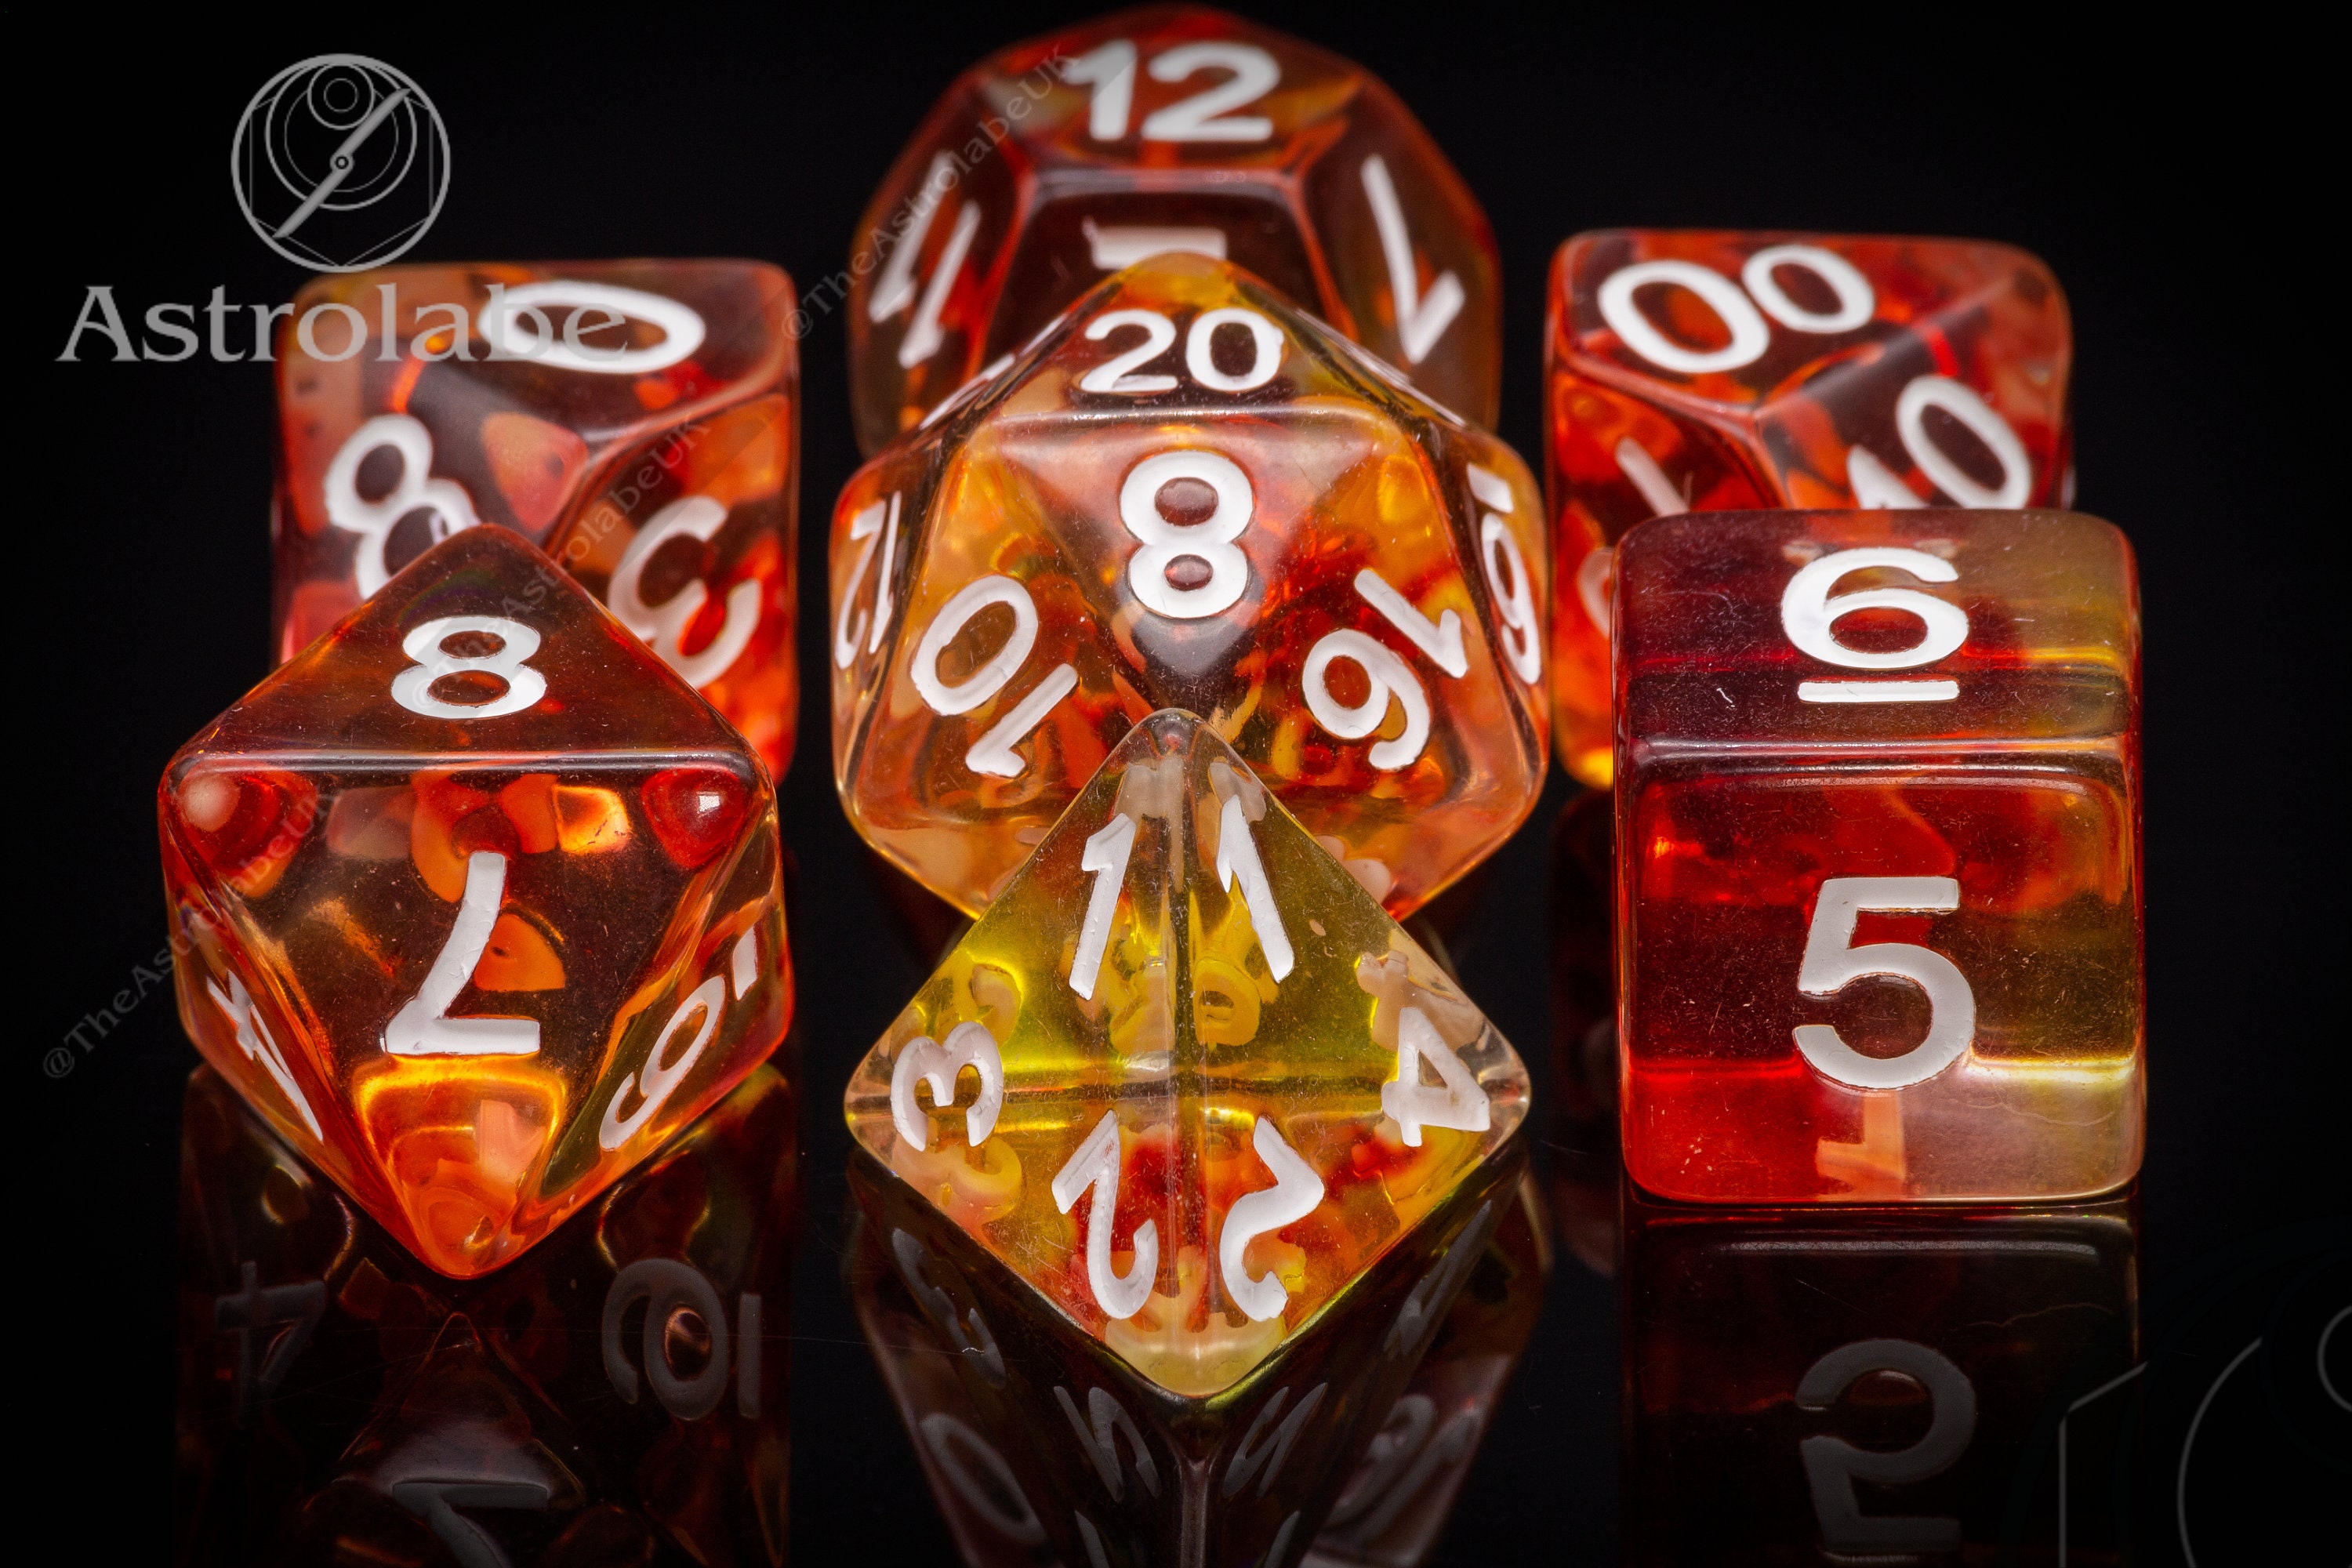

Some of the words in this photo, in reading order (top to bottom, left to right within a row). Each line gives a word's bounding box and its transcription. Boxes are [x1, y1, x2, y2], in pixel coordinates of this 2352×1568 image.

[1062, 38, 1281, 143] 12
[1080, 307, 1283, 394] 20
[1597, 245, 1876, 374] 00
[1120, 449, 1254, 619] 8
[390, 615, 547, 720] 8
[910, 574, 1078, 779] 10
[1301, 568, 1468, 771] 16
[1780, 546, 1970, 704] 6
[382, 851, 542, 1057] 7
[1068, 811, 1138, 1000] 1
[1215, 794, 1295, 984] 1
[1791, 875, 1976, 1091] 5
[890, 1021, 1005, 1152] 3
[1380, 1006, 1491, 1148] 4
[1051, 1109, 1160, 1320] 2
[1218, 1114, 1326, 1322] 2
